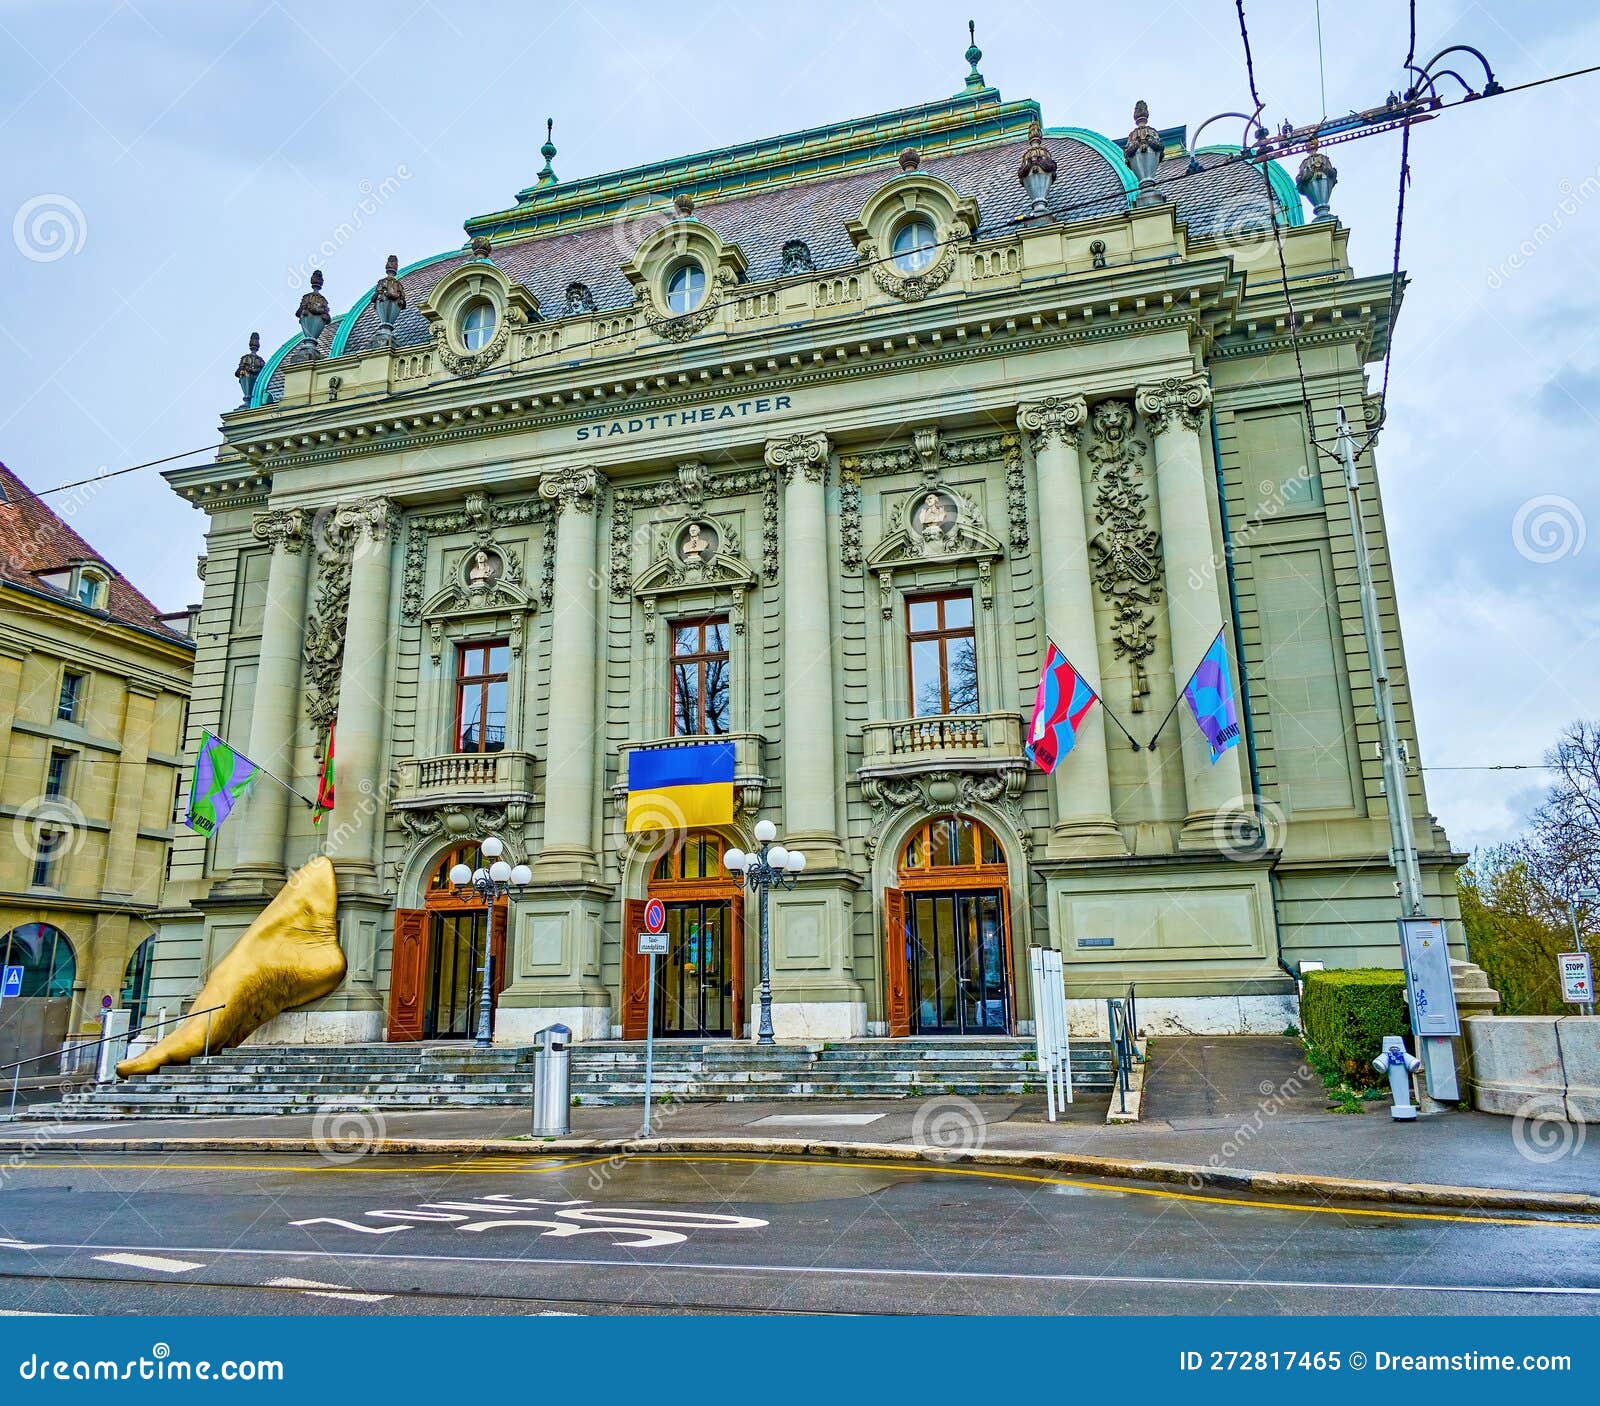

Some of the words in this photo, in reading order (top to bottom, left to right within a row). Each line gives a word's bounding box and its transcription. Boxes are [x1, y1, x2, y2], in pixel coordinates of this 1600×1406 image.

[576, 395, 792, 441] STADTTHEATER
[195, 815, 215, 832] BERN
[1565, 963, 1584, 971] STOPP
[288, 1194, 593, 1234] ZONE
[455, 1208, 770, 1247] 30
